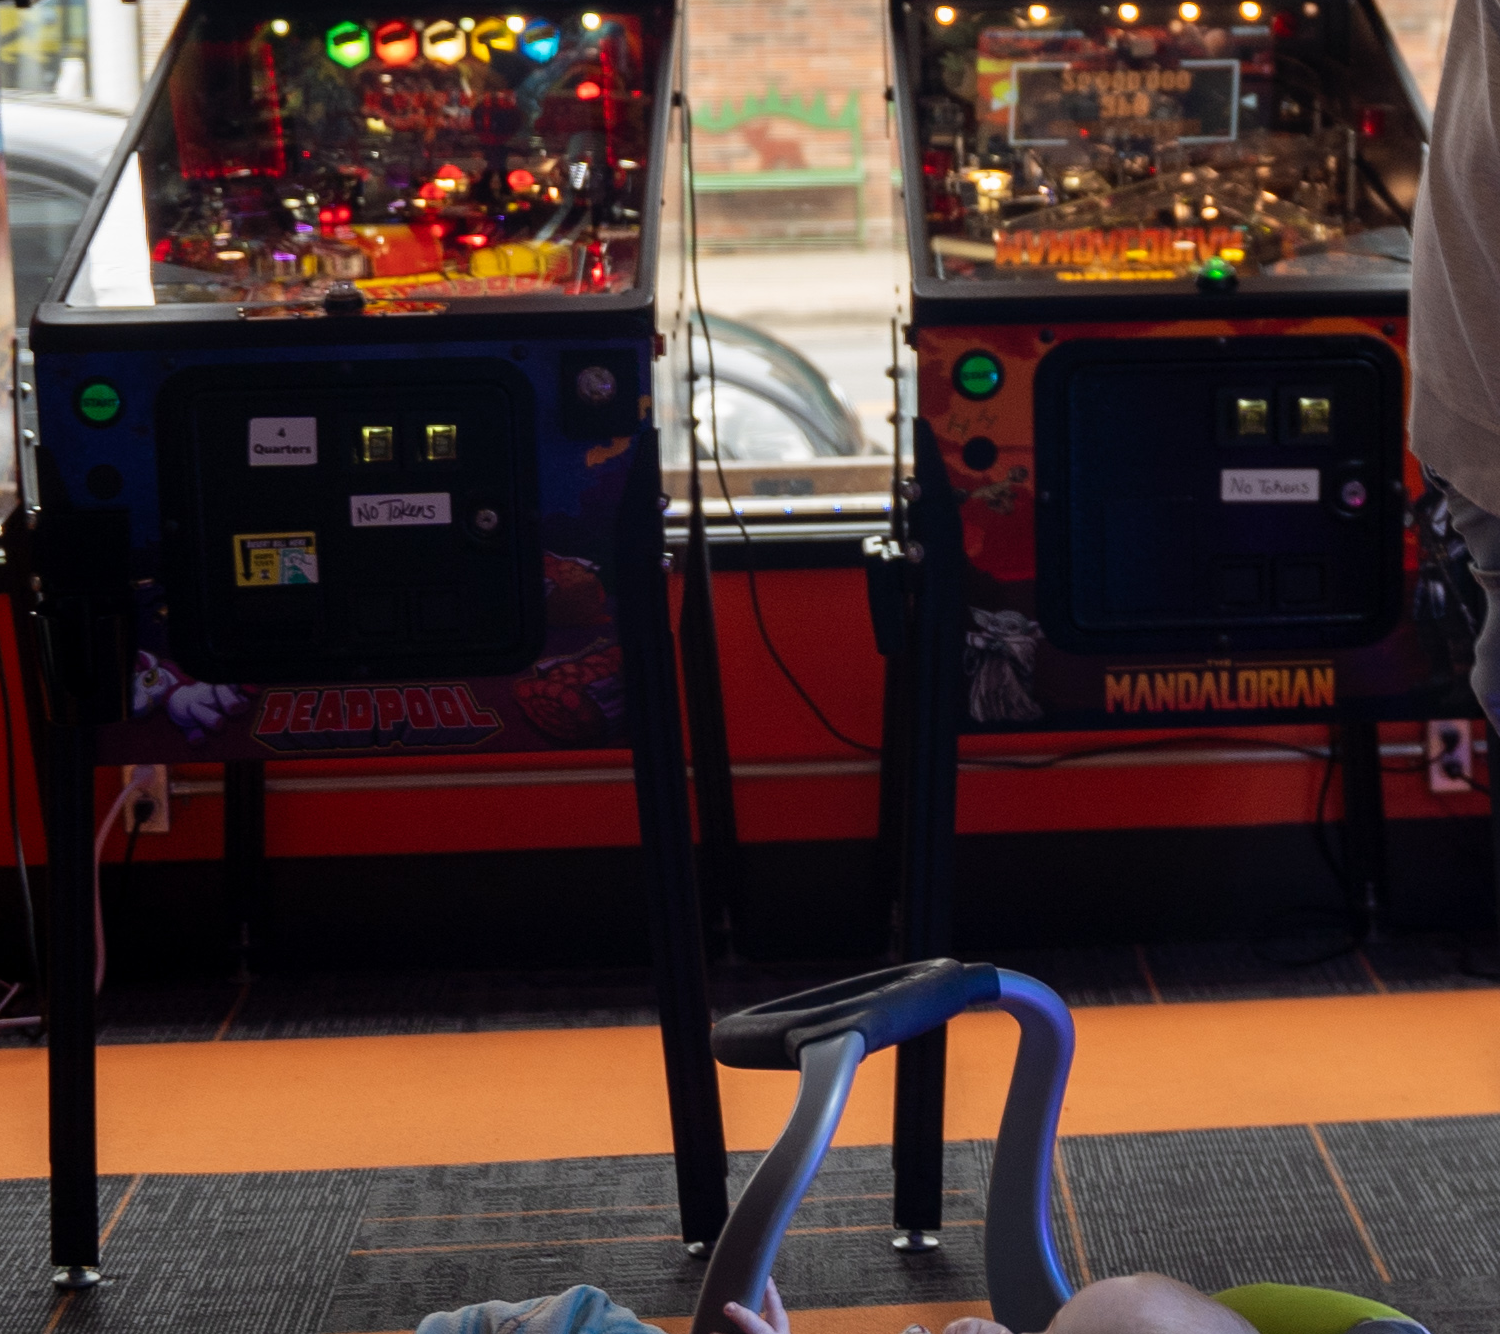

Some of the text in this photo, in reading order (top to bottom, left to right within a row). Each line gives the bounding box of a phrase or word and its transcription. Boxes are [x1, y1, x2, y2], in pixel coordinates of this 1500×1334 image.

[276, 428, 287, 439] 4
[253, 443, 313, 457] Quarters
[1230, 470, 1252, 495] No
[356, 502, 379, 522] No
[1104, 667, 1336, 714] MANDALORIAN
[254, 685, 501, 741] DEADPOOL
